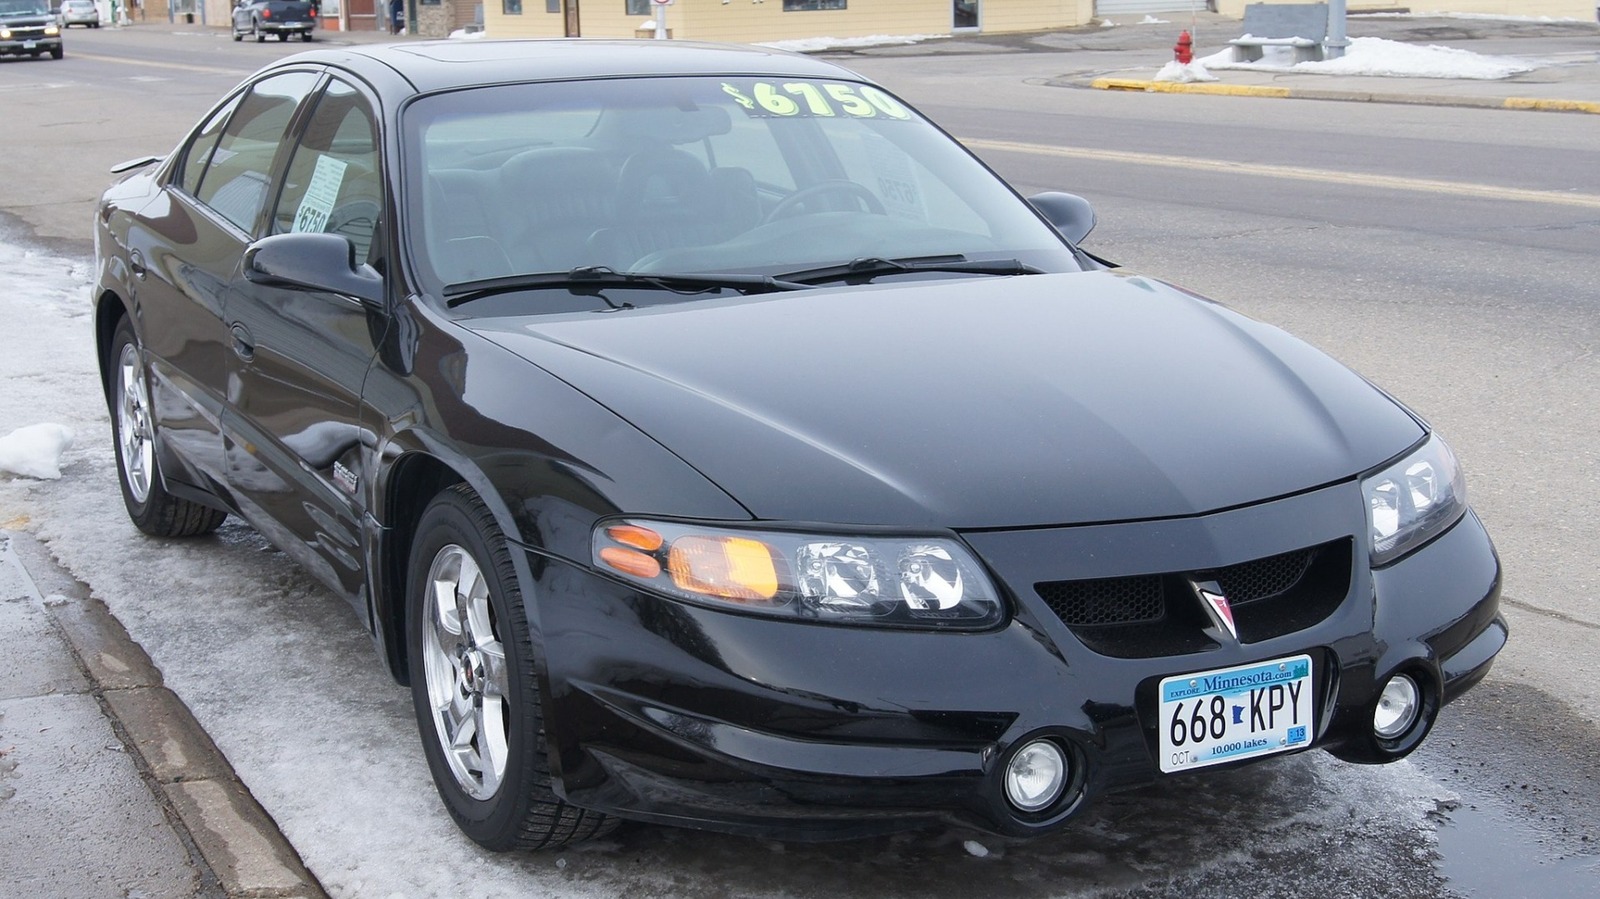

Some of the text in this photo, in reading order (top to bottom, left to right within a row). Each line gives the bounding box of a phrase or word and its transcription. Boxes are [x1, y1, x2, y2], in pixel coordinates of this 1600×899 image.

[721, 82, 911, 120] $6750
[1170, 687, 1200, 698] EXPLORE
[1170, 680, 1302, 747] 668 KPY
[1211, 738, 1268, 756] 10,000 lakes
[1171, 750, 1190, 766] OCT
